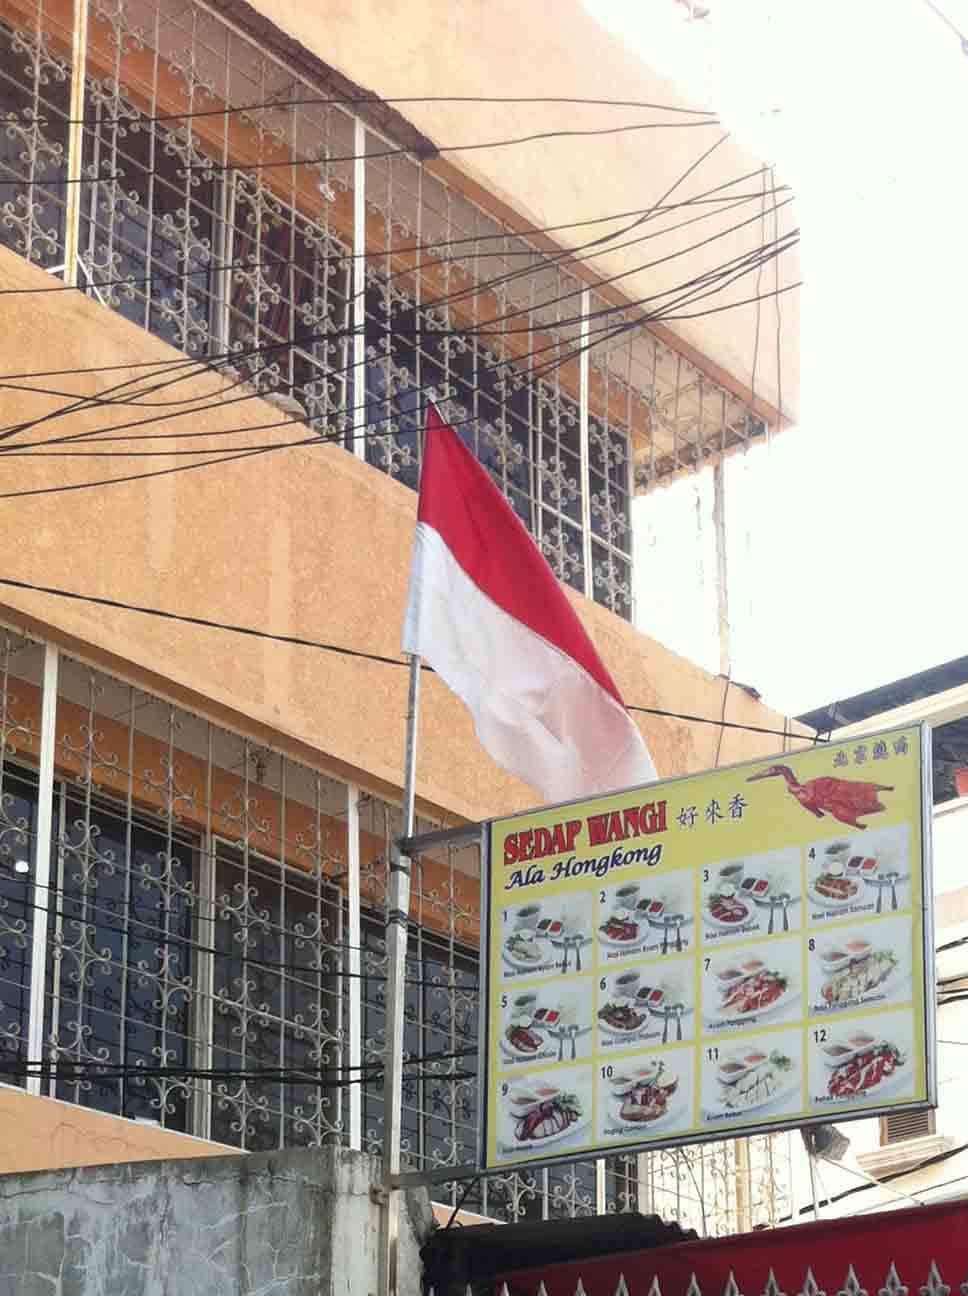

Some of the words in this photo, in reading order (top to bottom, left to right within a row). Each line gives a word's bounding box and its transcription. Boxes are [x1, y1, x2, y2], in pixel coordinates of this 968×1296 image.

[503, 819, 582, 866] SEDAP
[586, 799, 668, 848] WANGI
[808, 847, 816, 860] 4
[504, 868, 545, 890] Ala
[550, 843, 664, 882] Hongkong
[703, 870, 710, 882] 3
[599, 891, 607, 904] 2
[808, 938, 816, 951] 8
[704, 958, 712, 972] 7
[599, 978, 607, 991] 6
[814, 1029, 827, 1043] 12
[707, 1048, 719, 1061] 11
[601, 1065, 614, 1079] 10
[501, 1083, 509, 1096] 9
